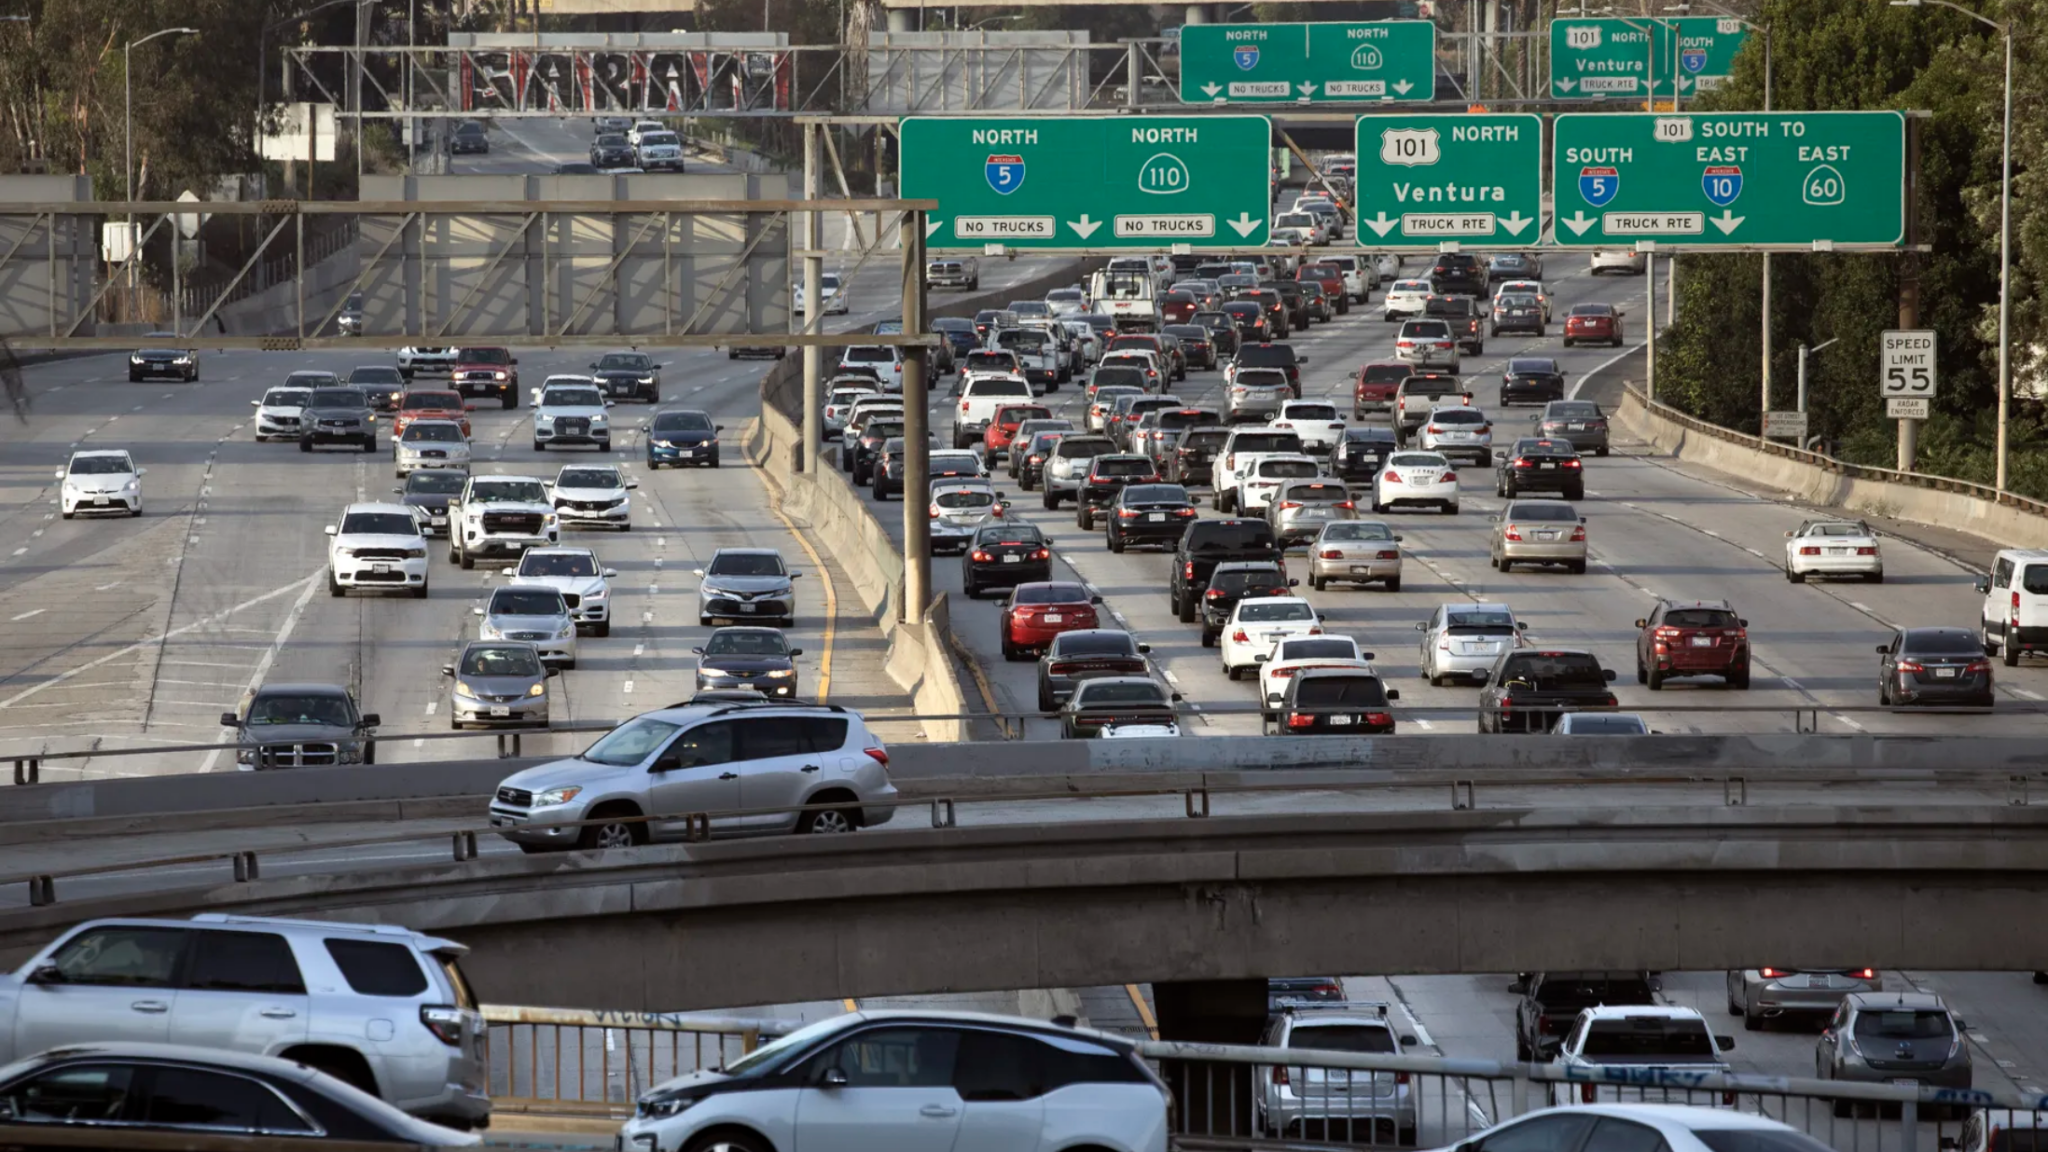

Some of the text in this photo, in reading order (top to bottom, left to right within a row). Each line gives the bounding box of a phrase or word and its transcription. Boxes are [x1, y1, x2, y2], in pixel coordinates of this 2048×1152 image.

[1721, 22, 1738, 31] 101
[1226, 30, 1267, 40] NORTH
[1347, 28, 1388, 38] NORTH
[1574, 33, 1595, 44] 101
[1242, 54, 1252, 66] 5
[1356, 52, 1376, 65] 110
[1690, 57, 1698, 68] 5
[1576, 59, 1643, 71] Ventura
[1234, 84, 1285, 93] NO TRUCKS
[1329, 83, 1381, 92] NO TRUCKS
[1585, 80, 1633, 89] TRUCK RTE
[1132, 128, 1197, 143] NORTH
[1664, 122, 1805, 137] 101 SOUTH TO
[973, 129, 1037, 145] NORTH
[1396, 126, 1518, 156] 101 NORTH
[1567, 148, 1632, 163] SOUTH
[1697, 146, 1748, 162] EAST
[1799, 146, 1850, 161] EAST
[998, 166, 1012, 184] 5
[1151, 167, 1181, 185] 110
[1393, 182, 1505, 202] Ventura
[1593, 178, 1605, 196] 5
[1712, 179, 1732, 197] 10
[1811, 179, 1837, 197] 60
[966, 222, 1044, 232] NO TRUCKS
[1126, 220, 1203, 231] NO TRUCKS
[1411, 219, 1487, 229] TRUCK RTE
[1615, 218, 1692, 228] TRUCK RTE
[1887, 339, 1931, 349] SPEED
[1892, 354, 1925, 364] LIMIT
[1887, 368, 1930, 391] 55
[1890, 409, 1925, 417] ENFORCED
